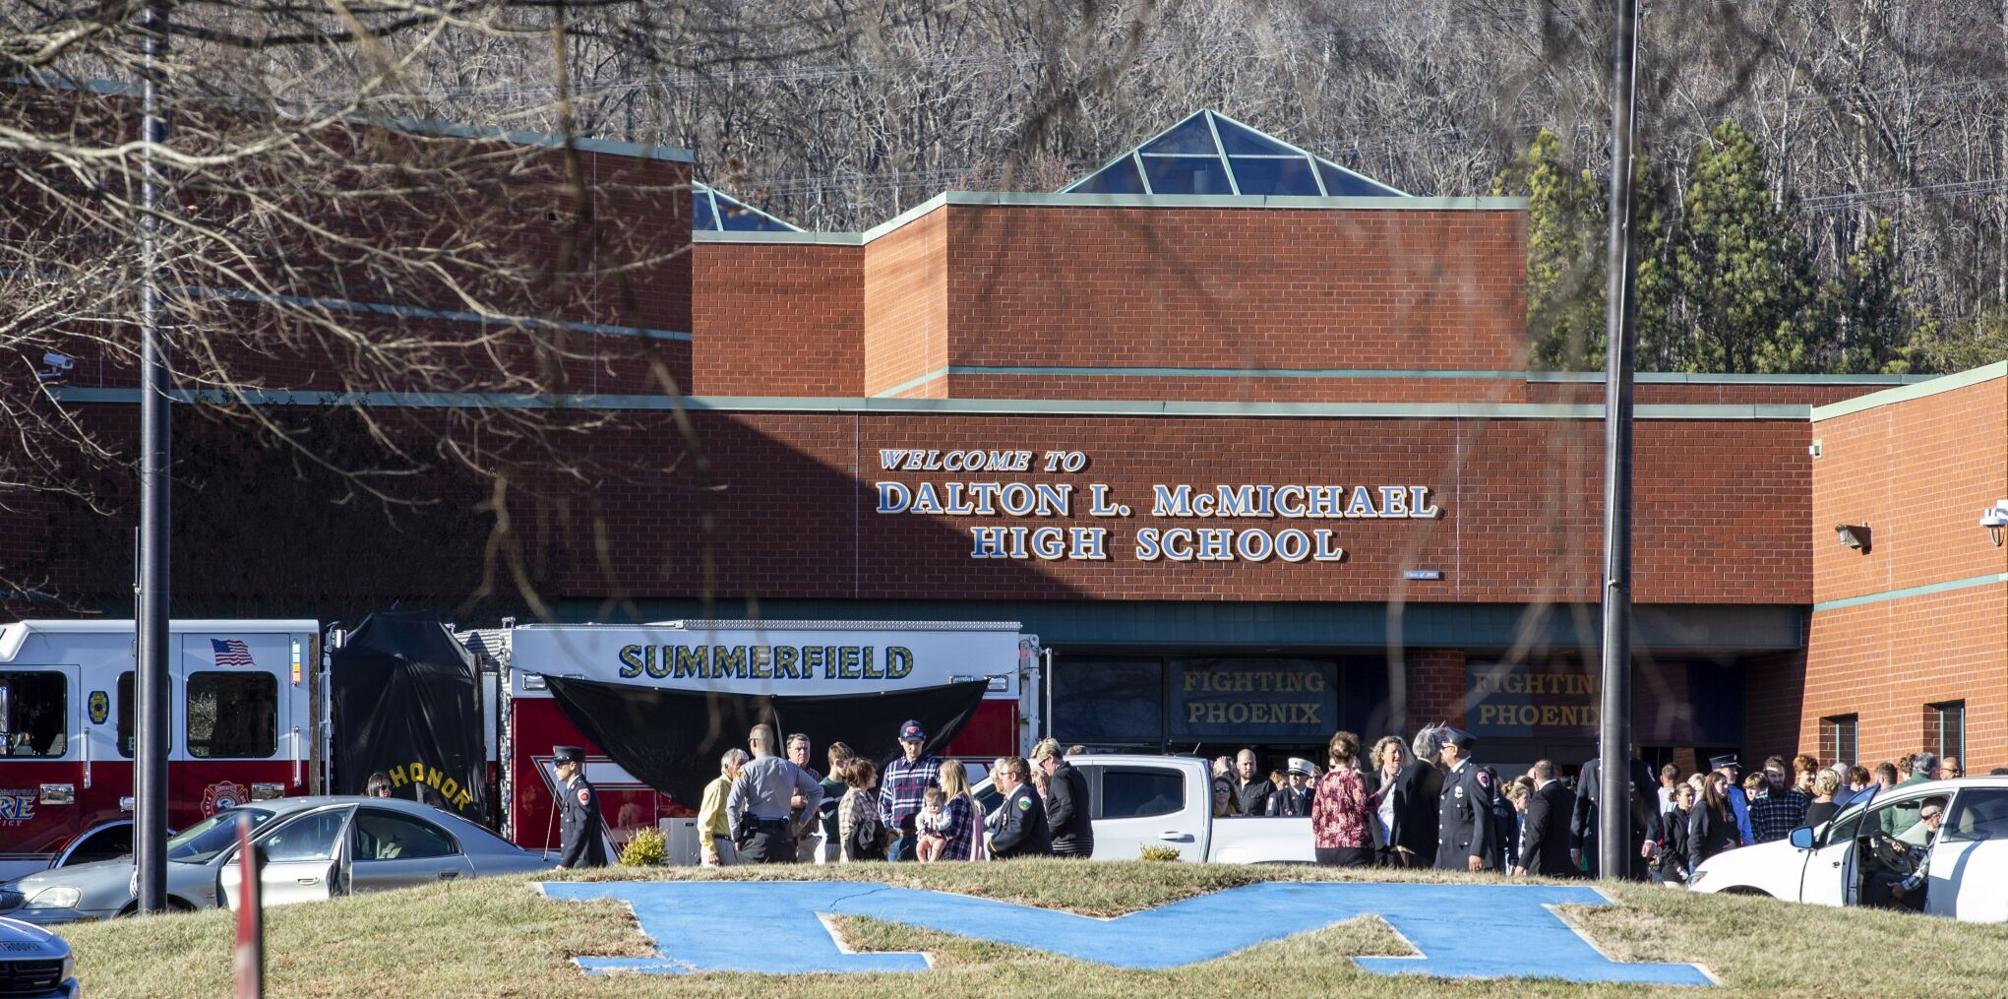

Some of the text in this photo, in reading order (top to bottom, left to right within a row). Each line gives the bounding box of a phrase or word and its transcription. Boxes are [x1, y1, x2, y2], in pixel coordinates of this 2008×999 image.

[879, 449, 1086, 473] WELCOME TO
[876, 481, 1439, 518] DALTON L. McMICHAEL
[970, 526, 1343, 562] HIGH SCHOOL
[619, 644, 914, 680] SUMMERFIELD
[1183, 671, 1326, 692] FIGHTING
[1188, 703, 1321, 723] PHOENIX
[388, 762, 472, 811] HONOR
